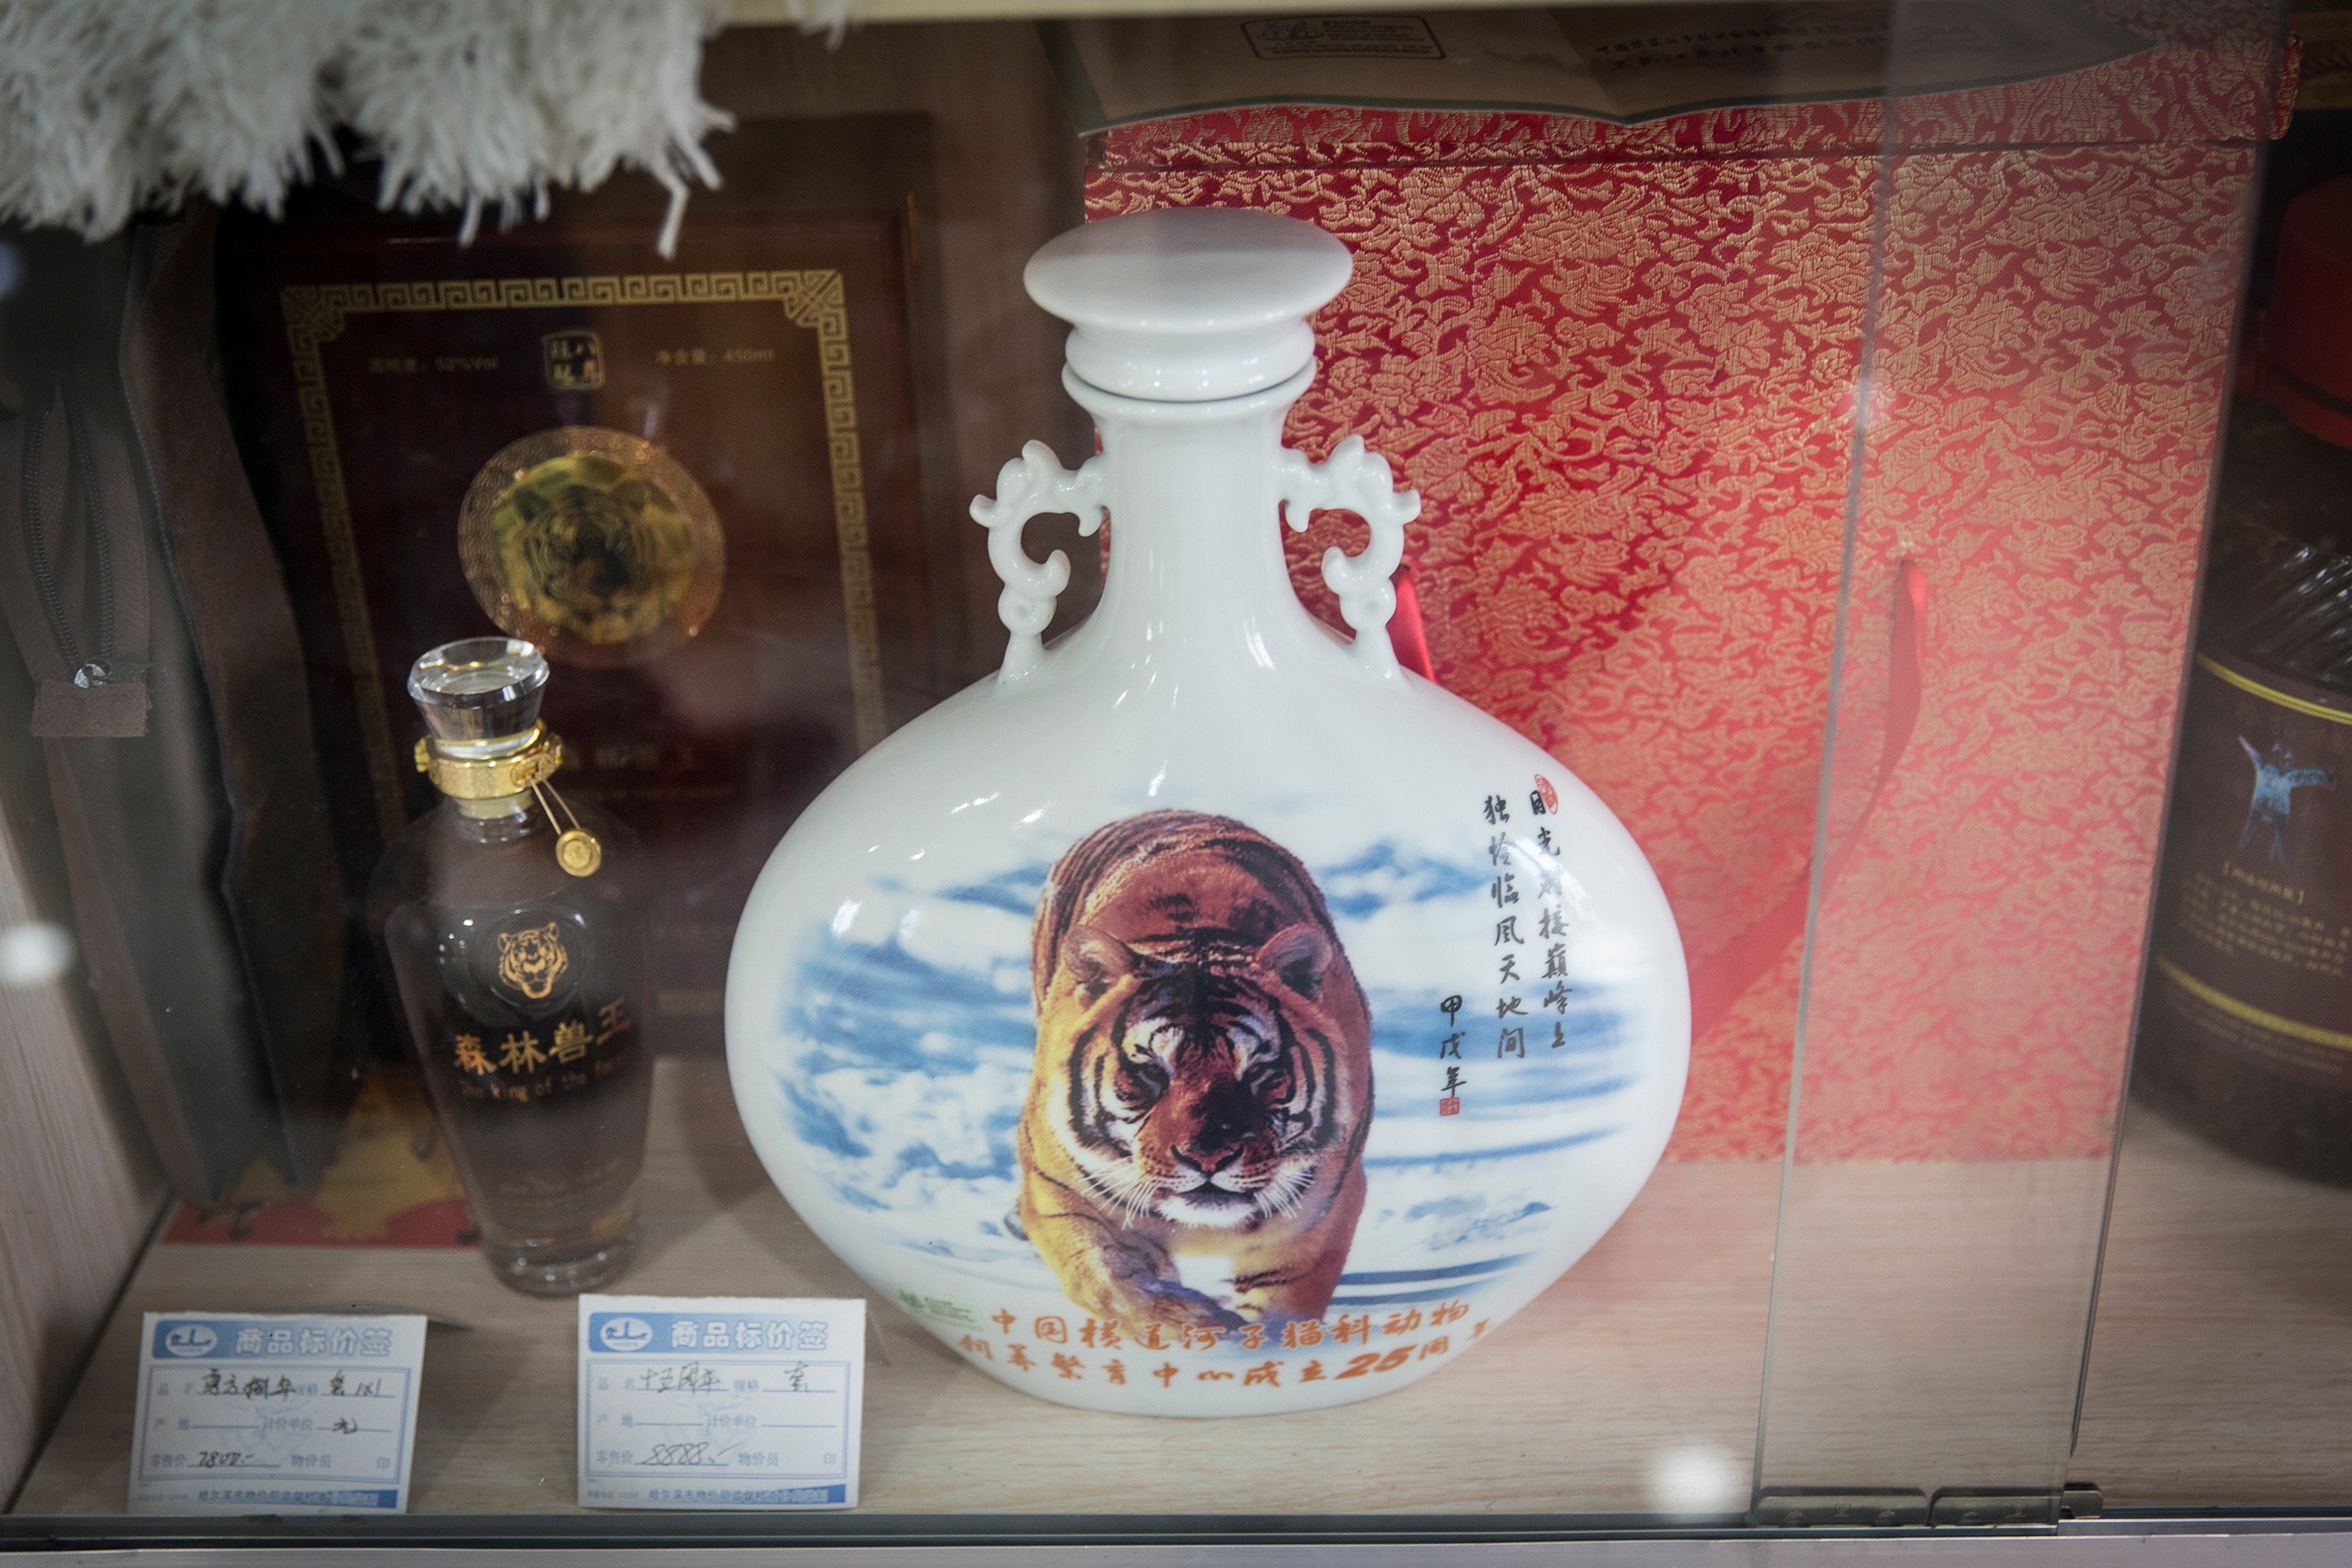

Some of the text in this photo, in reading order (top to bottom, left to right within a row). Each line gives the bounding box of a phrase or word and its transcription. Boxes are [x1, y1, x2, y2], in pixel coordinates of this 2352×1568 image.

[453, 998, 631, 1076] 森林兽王
[235, 1327, 393, 1357] 商品标价签
[671, 1321, 829, 1351] 商品标价签
[992, 1298, 1470, 1352] 中国横道河子猫科动物
